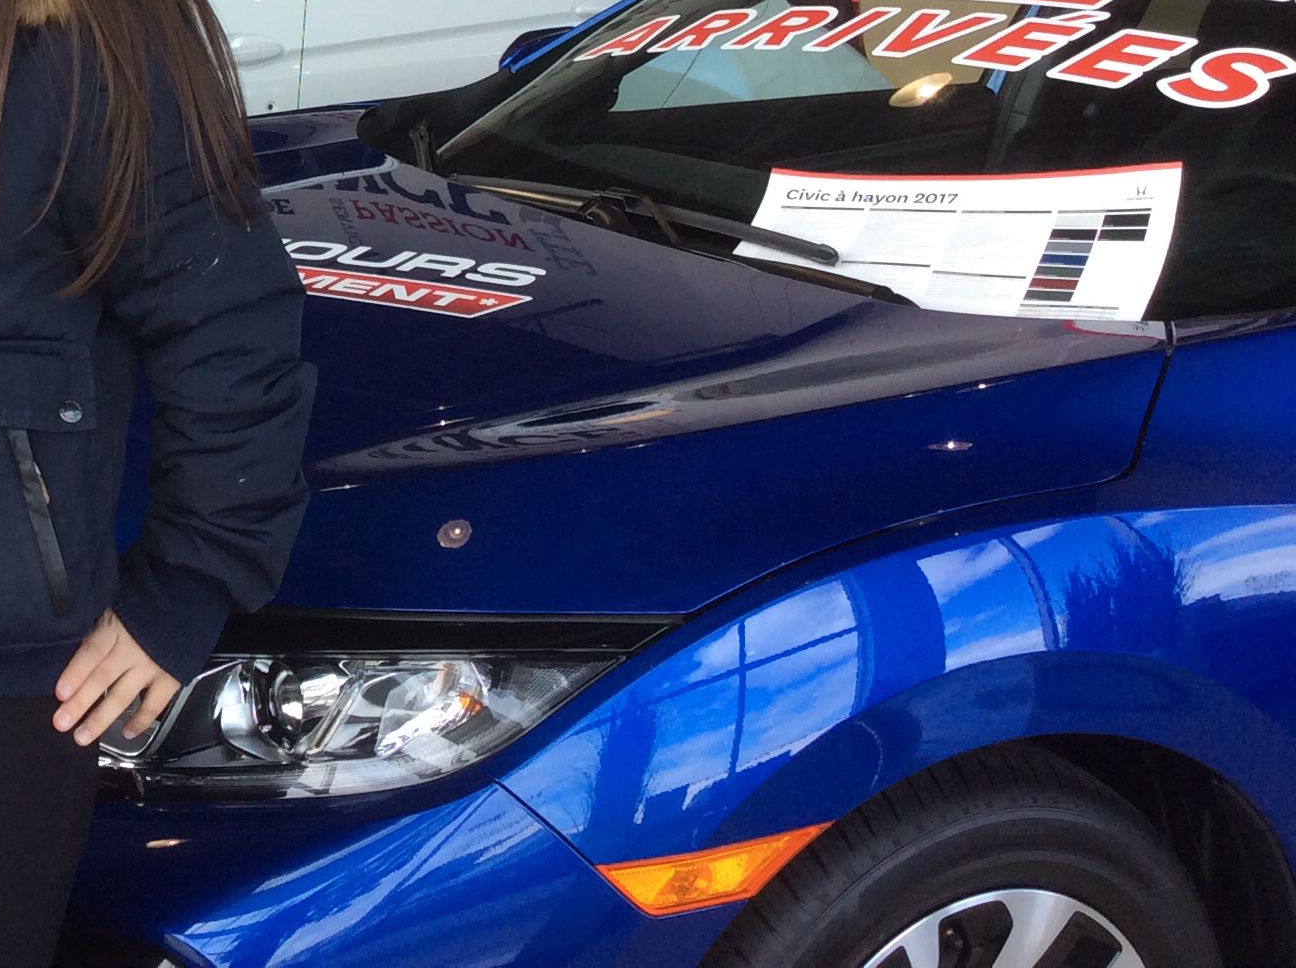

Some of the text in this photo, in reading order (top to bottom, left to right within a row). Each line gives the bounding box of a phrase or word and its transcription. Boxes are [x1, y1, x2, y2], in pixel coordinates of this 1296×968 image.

[575, 6, 1296, 108] ARRIVÉES
[786, 188, 959, 206] Civic à hayon 2017
[281, 239, 547, 287] OURS
